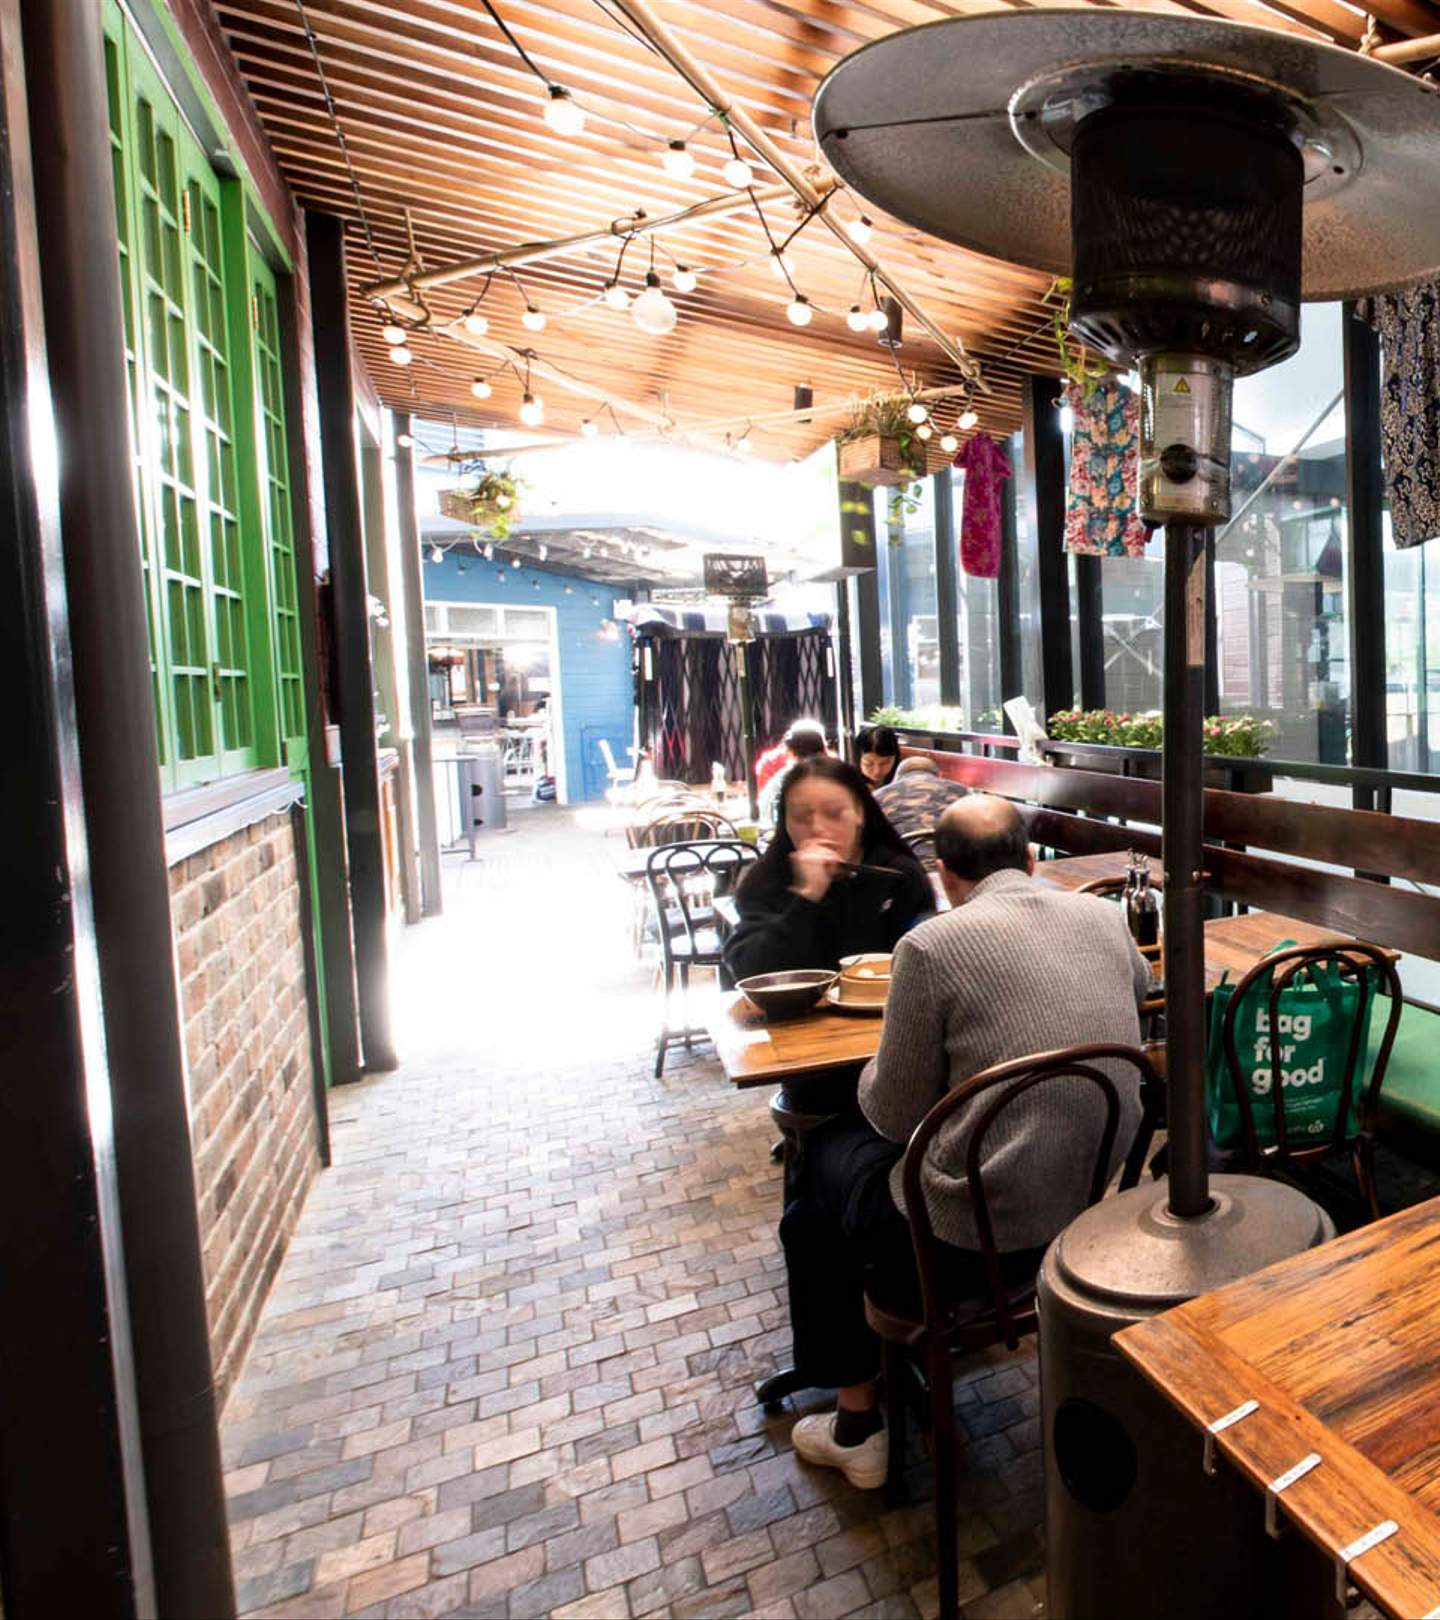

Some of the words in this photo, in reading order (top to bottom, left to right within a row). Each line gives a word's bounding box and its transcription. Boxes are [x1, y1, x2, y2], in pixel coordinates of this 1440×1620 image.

[1255, 1007, 1312, 1041] bag
[1253, 1036, 1296, 1063] for
[1252, 1057, 1324, 1095] good
